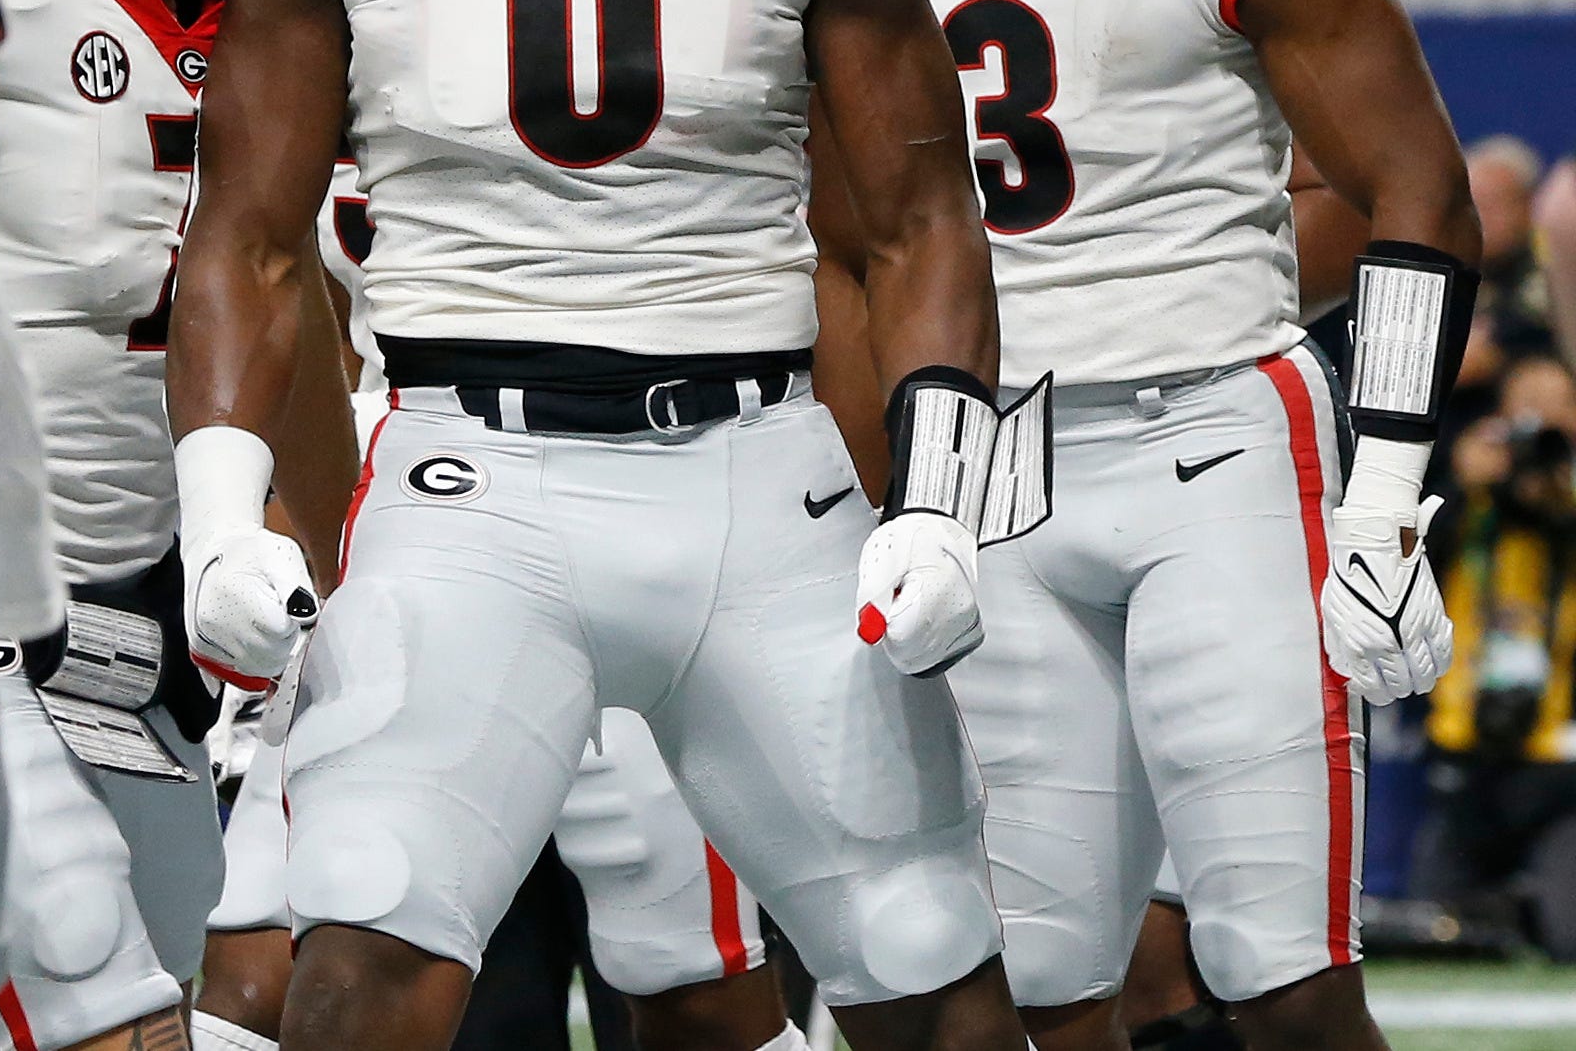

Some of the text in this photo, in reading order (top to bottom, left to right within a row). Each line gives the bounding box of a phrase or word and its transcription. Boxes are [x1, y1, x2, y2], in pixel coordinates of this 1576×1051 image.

[74, 33, 128, 100] SEC
[177, 51, 208, 82] G
[406, 456, 481, 499] G
